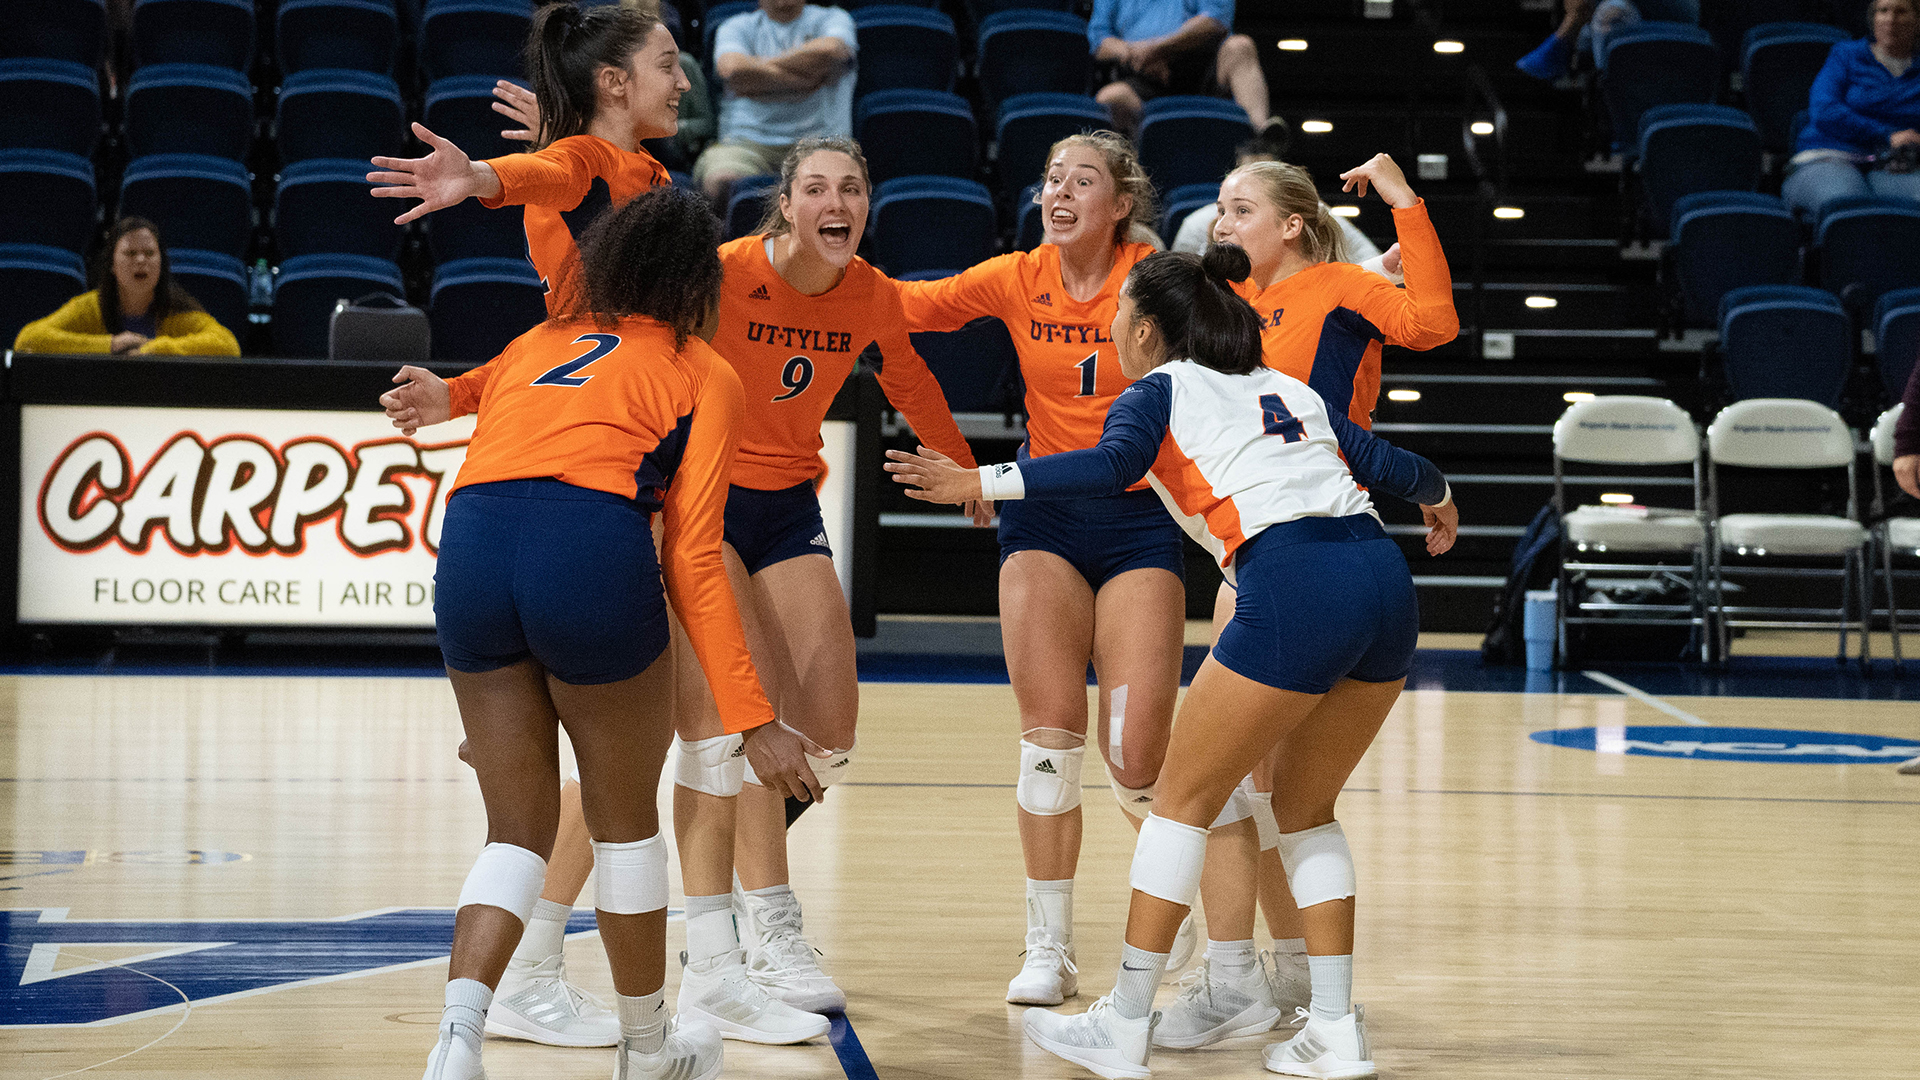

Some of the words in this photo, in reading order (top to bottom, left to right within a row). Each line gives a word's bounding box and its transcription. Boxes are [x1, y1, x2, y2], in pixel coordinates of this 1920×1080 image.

[1061, 325, 1114, 343] TYL
[529, 333, 622, 388] 2
[771, 355, 814, 403] 9
[1073, 350, 1099, 398] 1
[1258, 393, 1309, 444] 4
[94, 577, 206, 605] FLOOR
[218, 579, 301, 606] CARE
[340, 580, 394, 607] AIR
